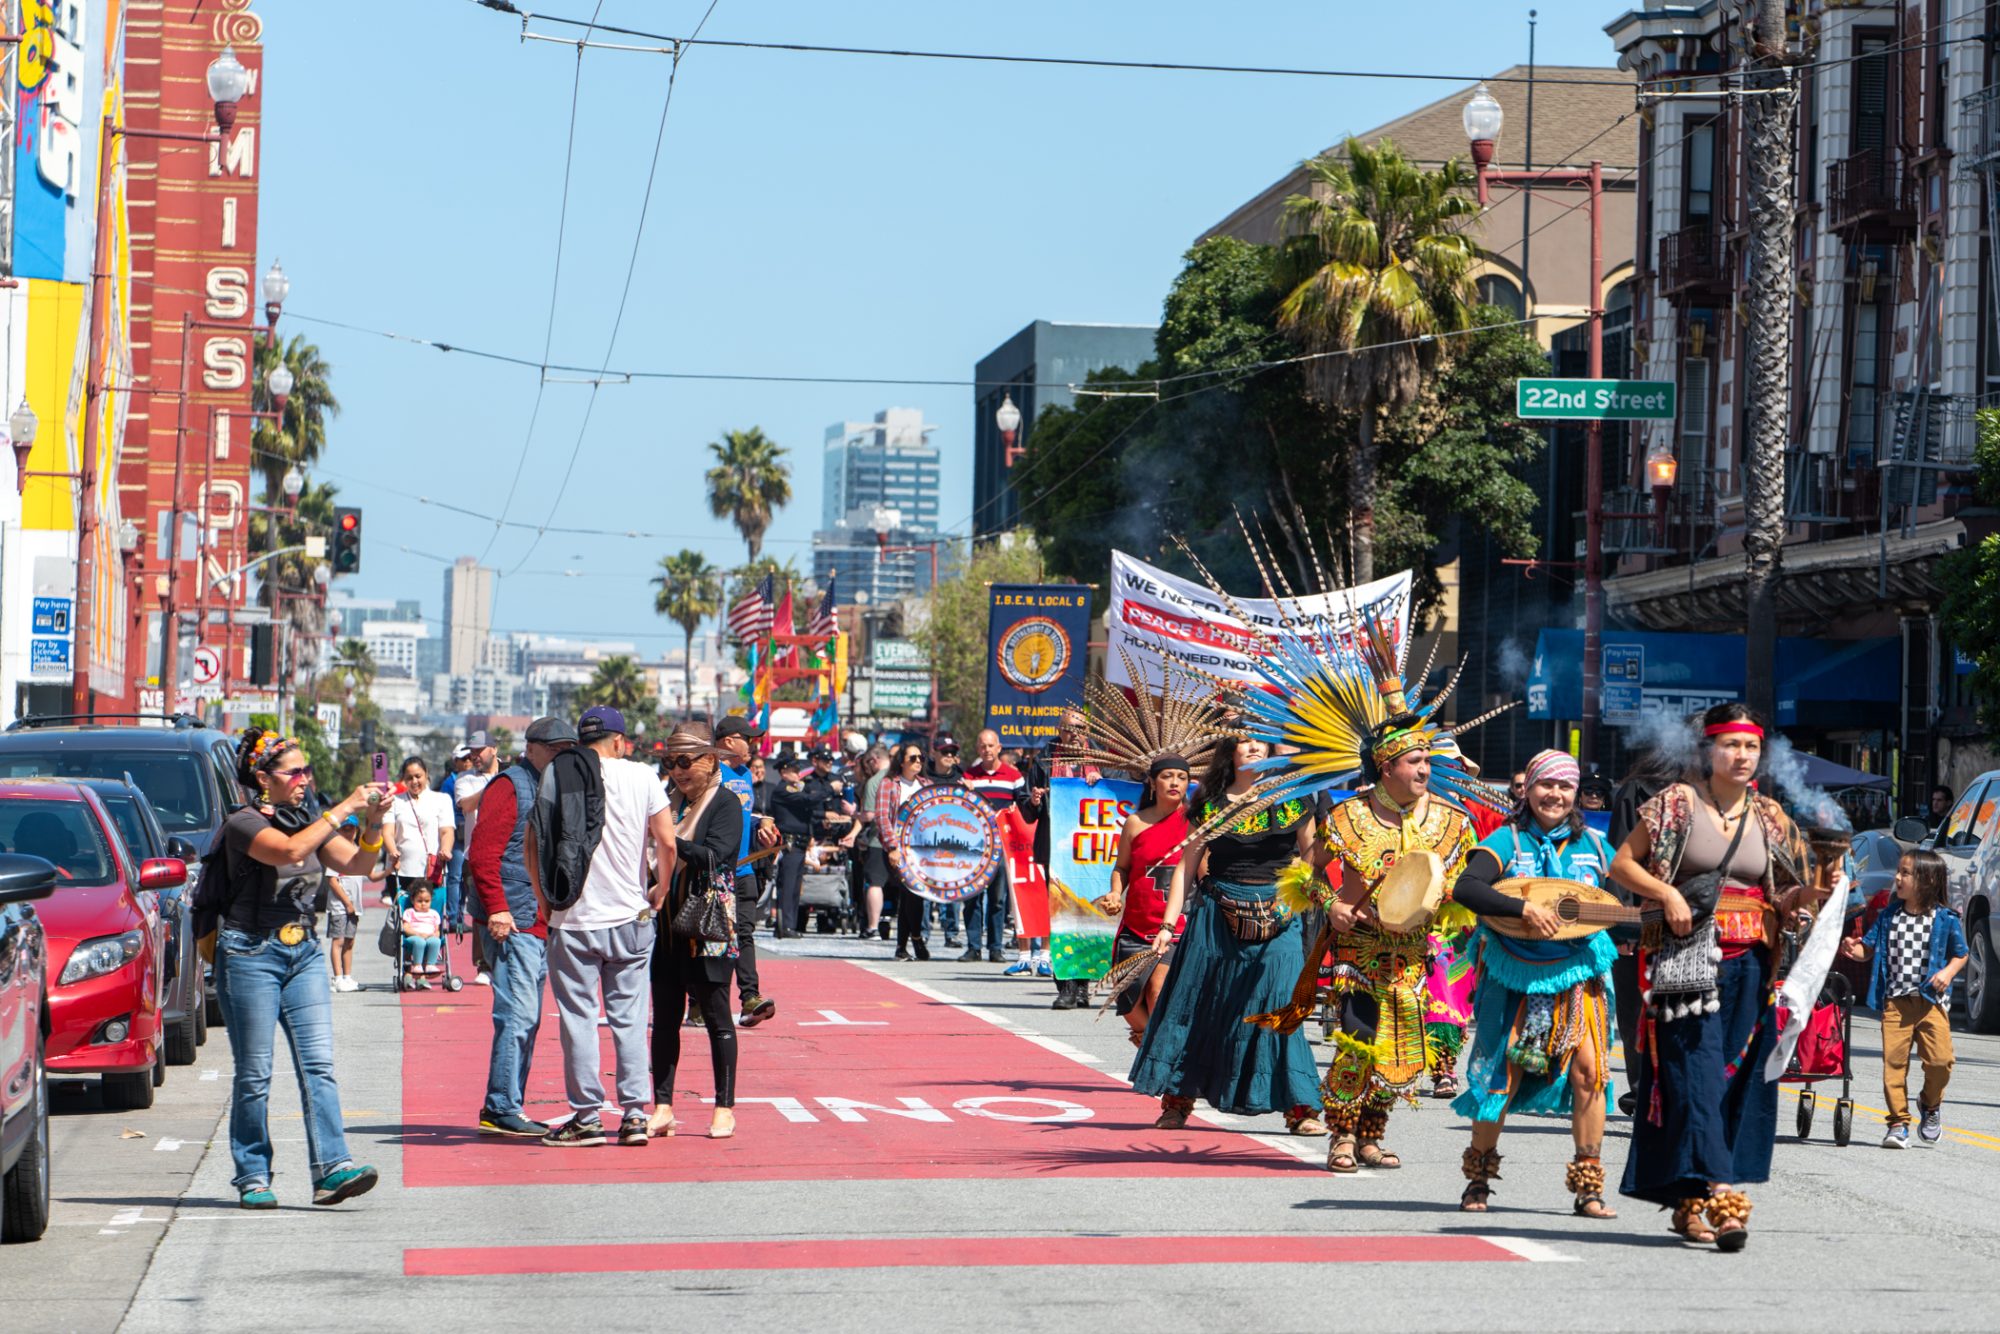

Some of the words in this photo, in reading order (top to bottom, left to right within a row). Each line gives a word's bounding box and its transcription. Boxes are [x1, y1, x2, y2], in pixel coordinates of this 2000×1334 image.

[1525, 388, 1586, 409] 22nd
[1594, 389, 1666, 410] Street
[1126, 573, 1158, 596] WE
[35, 600, 50, 610] Pay
[51, 600, 69, 609] here
[995, 595, 1036, 606] I.B.E.W.
[1039, 596, 1073, 607] LOCAL
[1128, 607, 1193, 638] PEACE
[1195, 626, 1206, 639] &
[1210, 630, 1268, 653] FREE
[1179, 653, 1221, 665] NEED
[1607, 649, 1622, 657] Pay
[1622, 649, 1640, 657] here
[991, 704, 1012, 716] SAN
[1016, 705, 1066, 717] FRANCIS
[1079, 798, 1136, 830] CES
[1073, 832, 1121, 865] CHA
